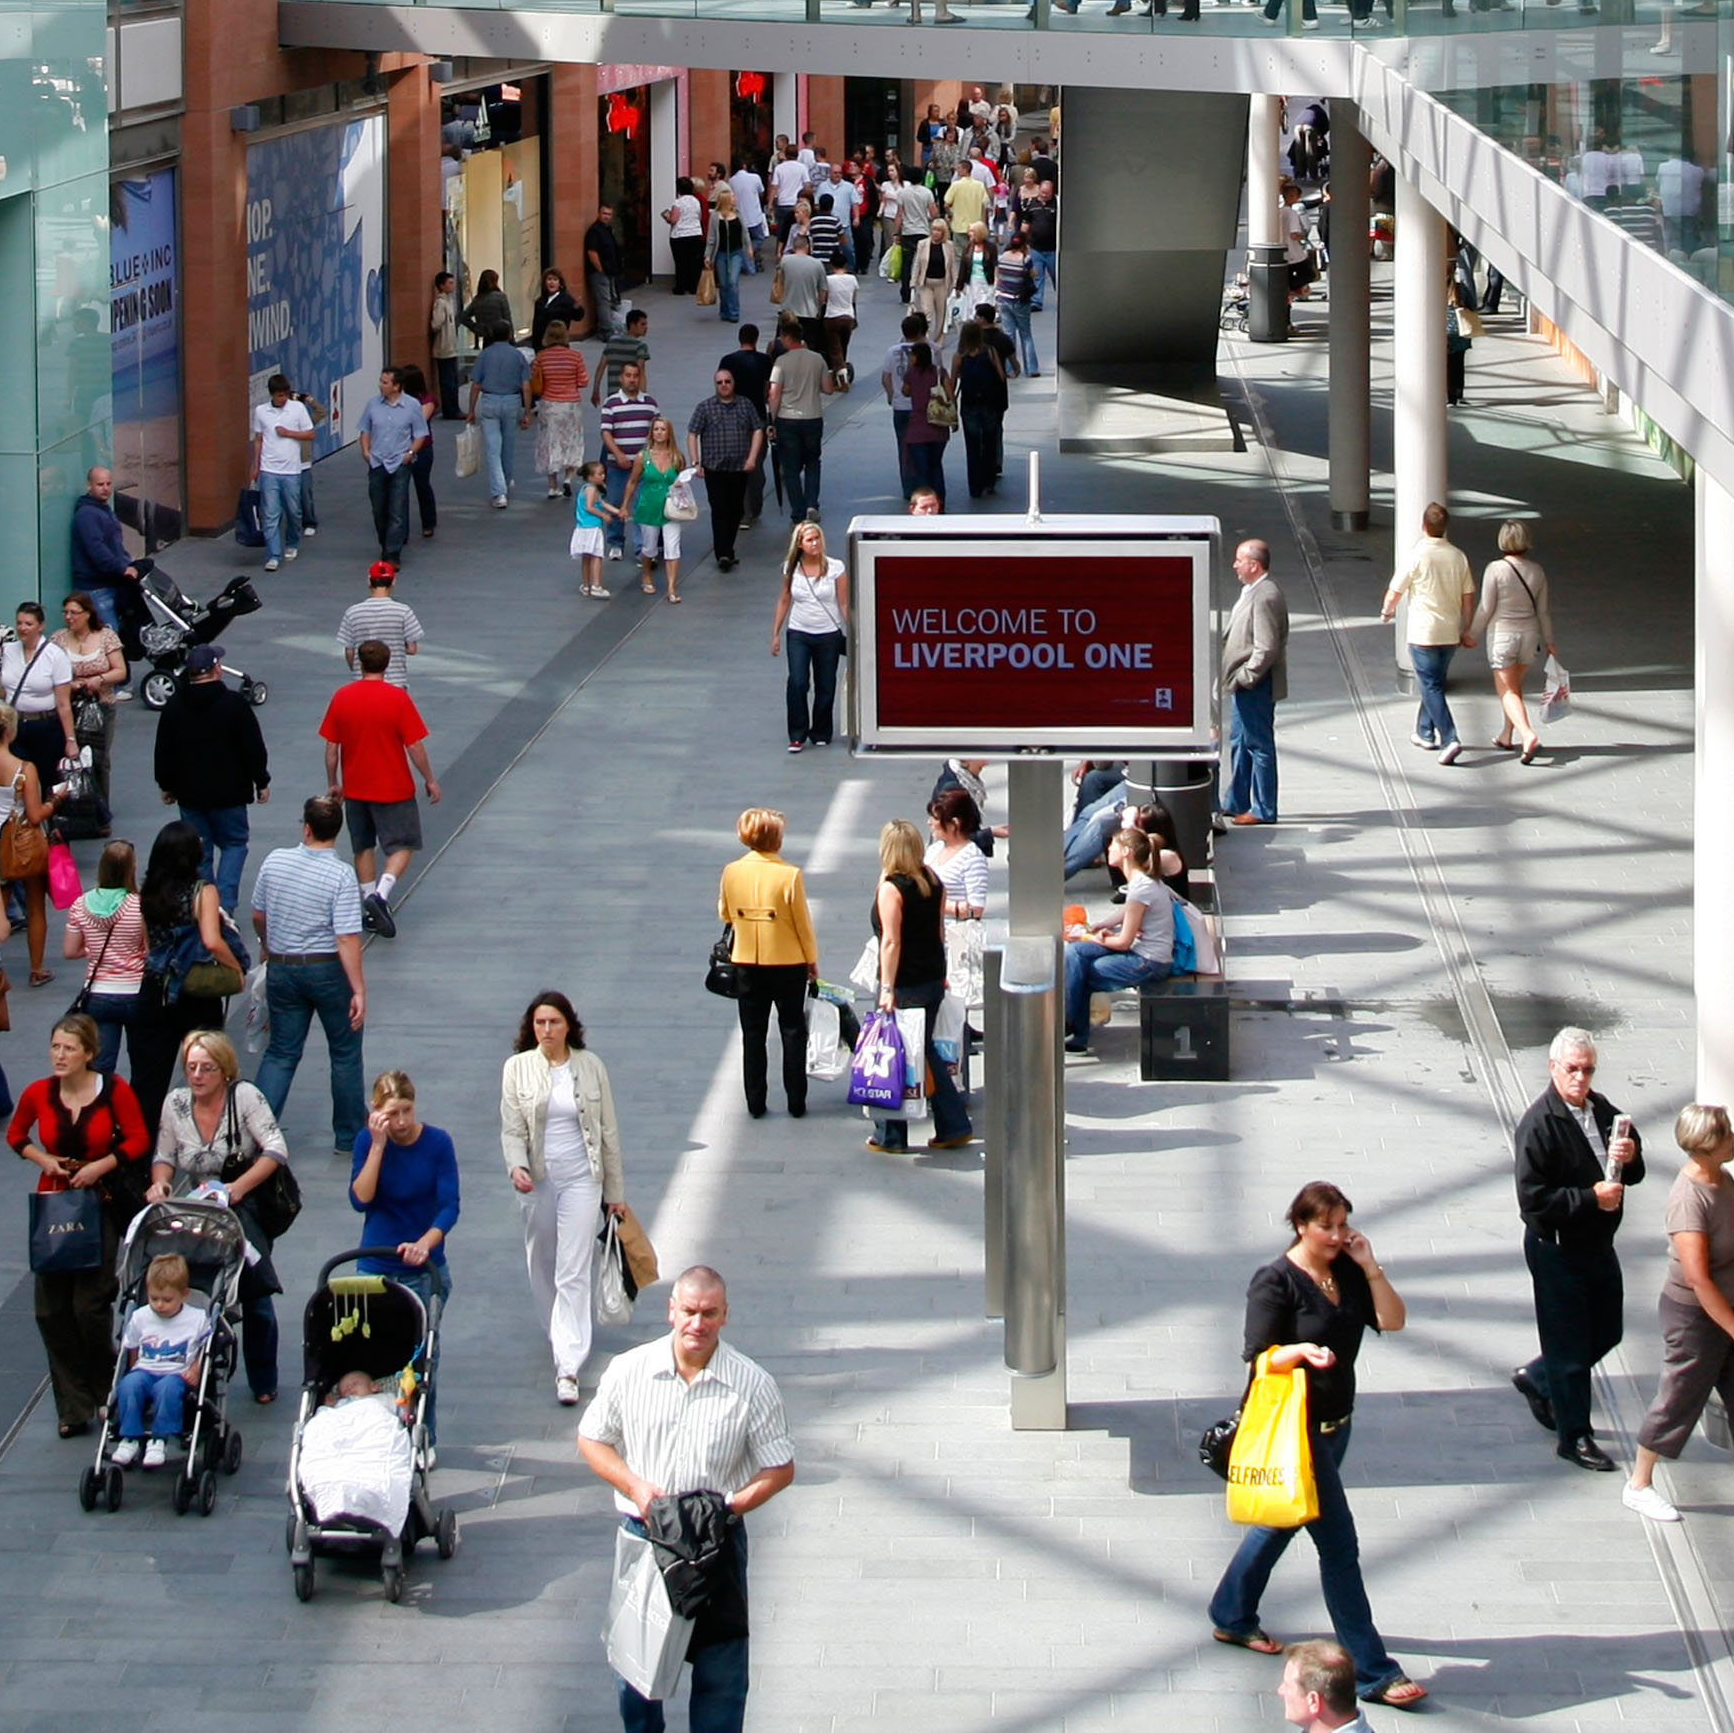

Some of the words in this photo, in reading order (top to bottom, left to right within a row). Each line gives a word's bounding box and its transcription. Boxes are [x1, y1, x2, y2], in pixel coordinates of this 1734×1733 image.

[247, 199, 273, 244] OP.
[151, 245, 172, 272] INC
[247, 253, 270, 297] NE.
[148, 277, 173, 319] SOON
[248, 300, 293, 353] WIND.
[892, 608, 1048, 634] WELCOME
[1057, 608, 1097, 634] TO
[893, 642, 1074, 668] LIVERPOOL
[1084, 642, 1153, 668] ONE
[1173, 1026, 1197, 1058] 1
[49, 1221, 84, 1234] ZARA
